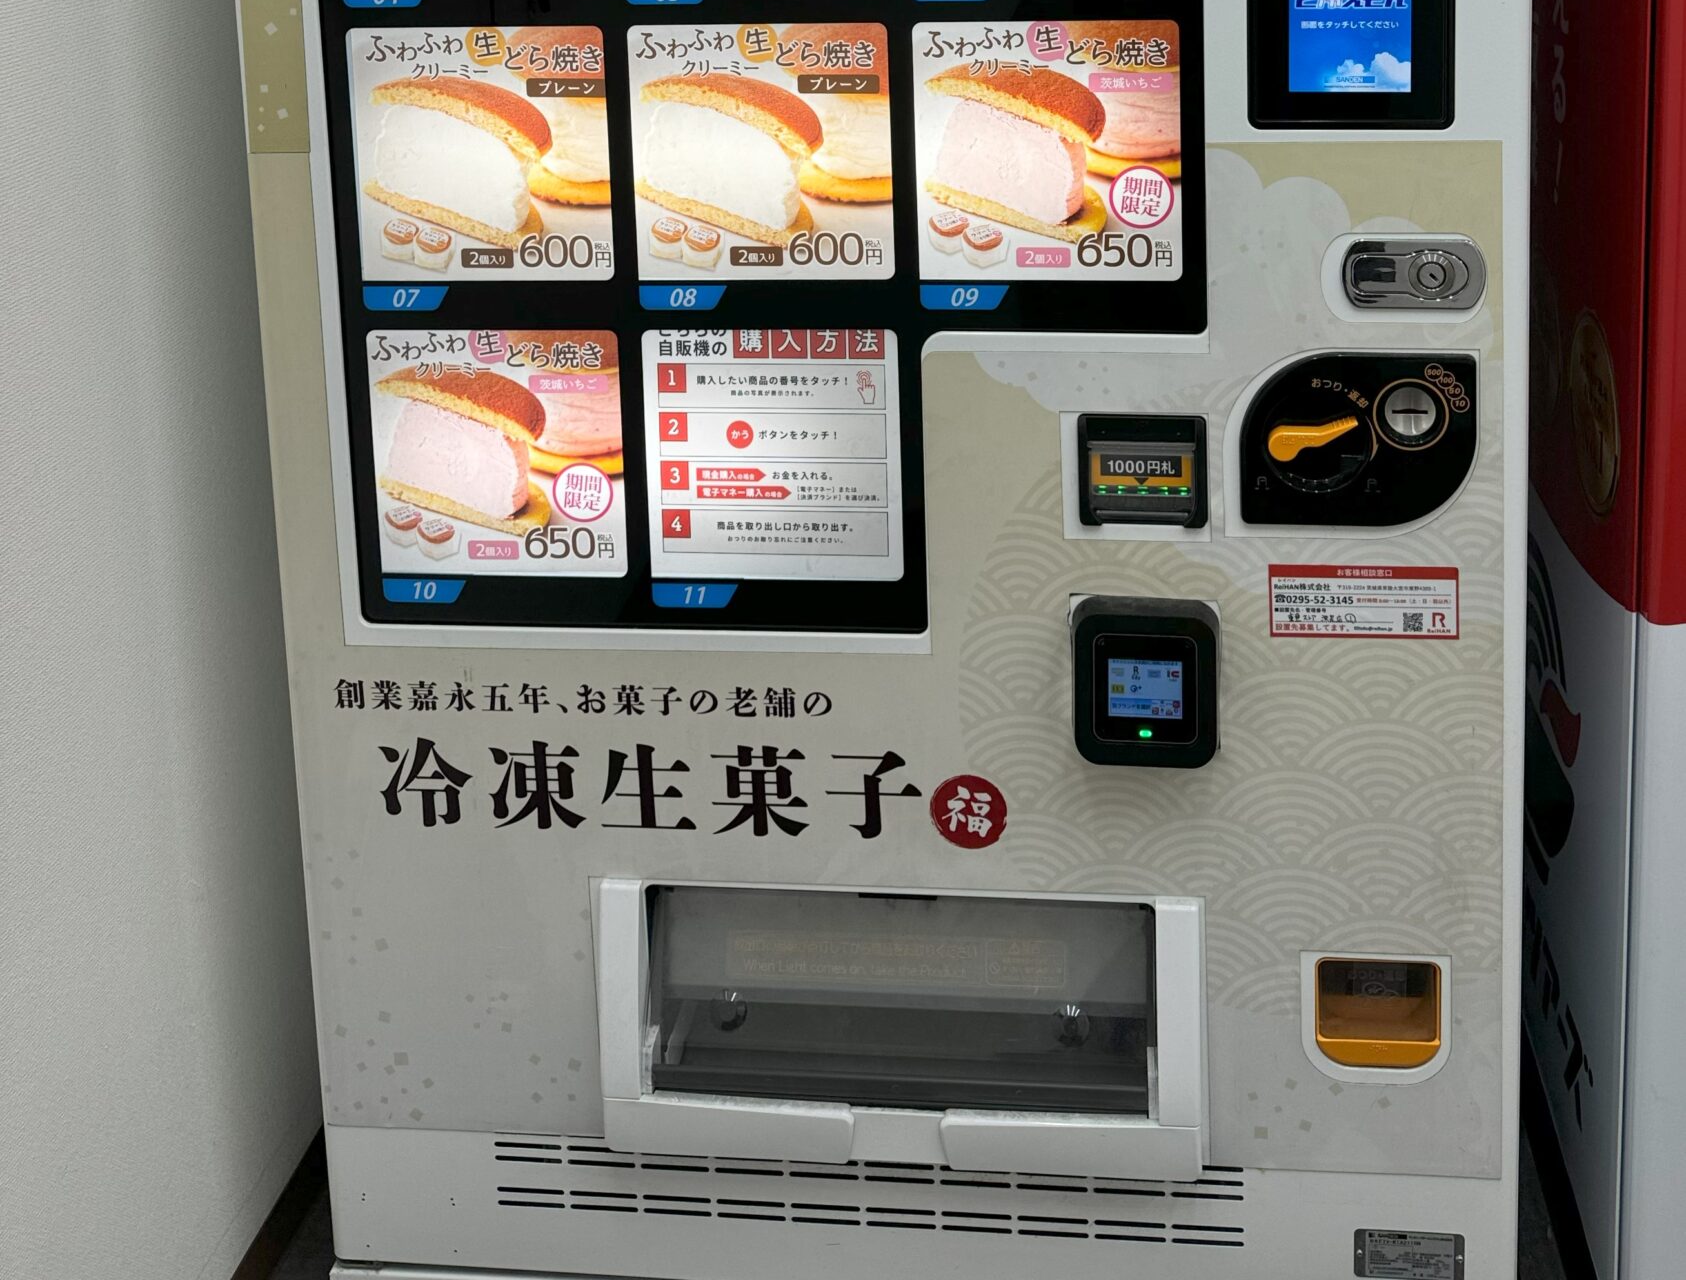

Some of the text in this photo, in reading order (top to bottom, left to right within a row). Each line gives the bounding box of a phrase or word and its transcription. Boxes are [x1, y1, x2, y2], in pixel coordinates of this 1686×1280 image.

[1301, 20, 1399, 29] 画面をタッチしてください
[366, 31, 603, 72] ふわふわ生どら焼き
[635, 28, 876, 68] ふわふわ生どら焼き
[923, 26, 1169, 67] ふわふわ生どら焼き
[411, 64, 488, 80] クリーミー
[682, 60, 759, 77] クリーミー
[969, 58, 1049, 76] クリーミー
[538, 82, 595, 95] プレーン
[810, 78, 868, 91] プレーン
[1100, 76, 1162, 89] 茨城いちご
[1123, 176, 1163, 198] 期間
[1121, 196, 1161, 218] 限定
[469, 251, 506, 265] 2個入り
[738, 249, 775, 263] 2個入り
[1025, 250, 1063, 265] 2個入り
[392, 289, 420, 308] 07
[670, 288, 697, 307] 08
[951, 288, 979, 307] 09
[371, 331, 603, 369] ふわふわ生どら焼き
[659, 329, 879, 357] 自販機の 購入方法
[416, 362, 491, 379] クリーミー
[668, 369, 676, 386] 1
[538, 378, 598, 390] 茨城いちご
[668, 419, 680, 436] 2
[731, 429, 749, 440] かう
[1107, 458, 1176, 475] 1000円札
[565, 472, 602, 494] 期間
[669, 467, 681, 484] 3
[772, 471, 833, 481] お金を入れる。
[563, 491, 601, 512] 限定
[671, 516, 853, 532] 4 商品を取り出し口から取り出す。
[475, 543, 512, 556] 2個入り
[1337, 569, 1392, 577] お客様相談窓口
[413, 581, 437, 599] 10
[684, 586, 706, 604] 11
[1286, 595, 1354, 605] 0295-52-3145
[1276, 623, 1349, 632] 設置先募集してます。
[334, 678, 833, 719] 創業嘉永五年、お菓子の老舗の
[377, 736, 922, 840] 冷凍生菓子
[940, 785, 992, 839] 福
